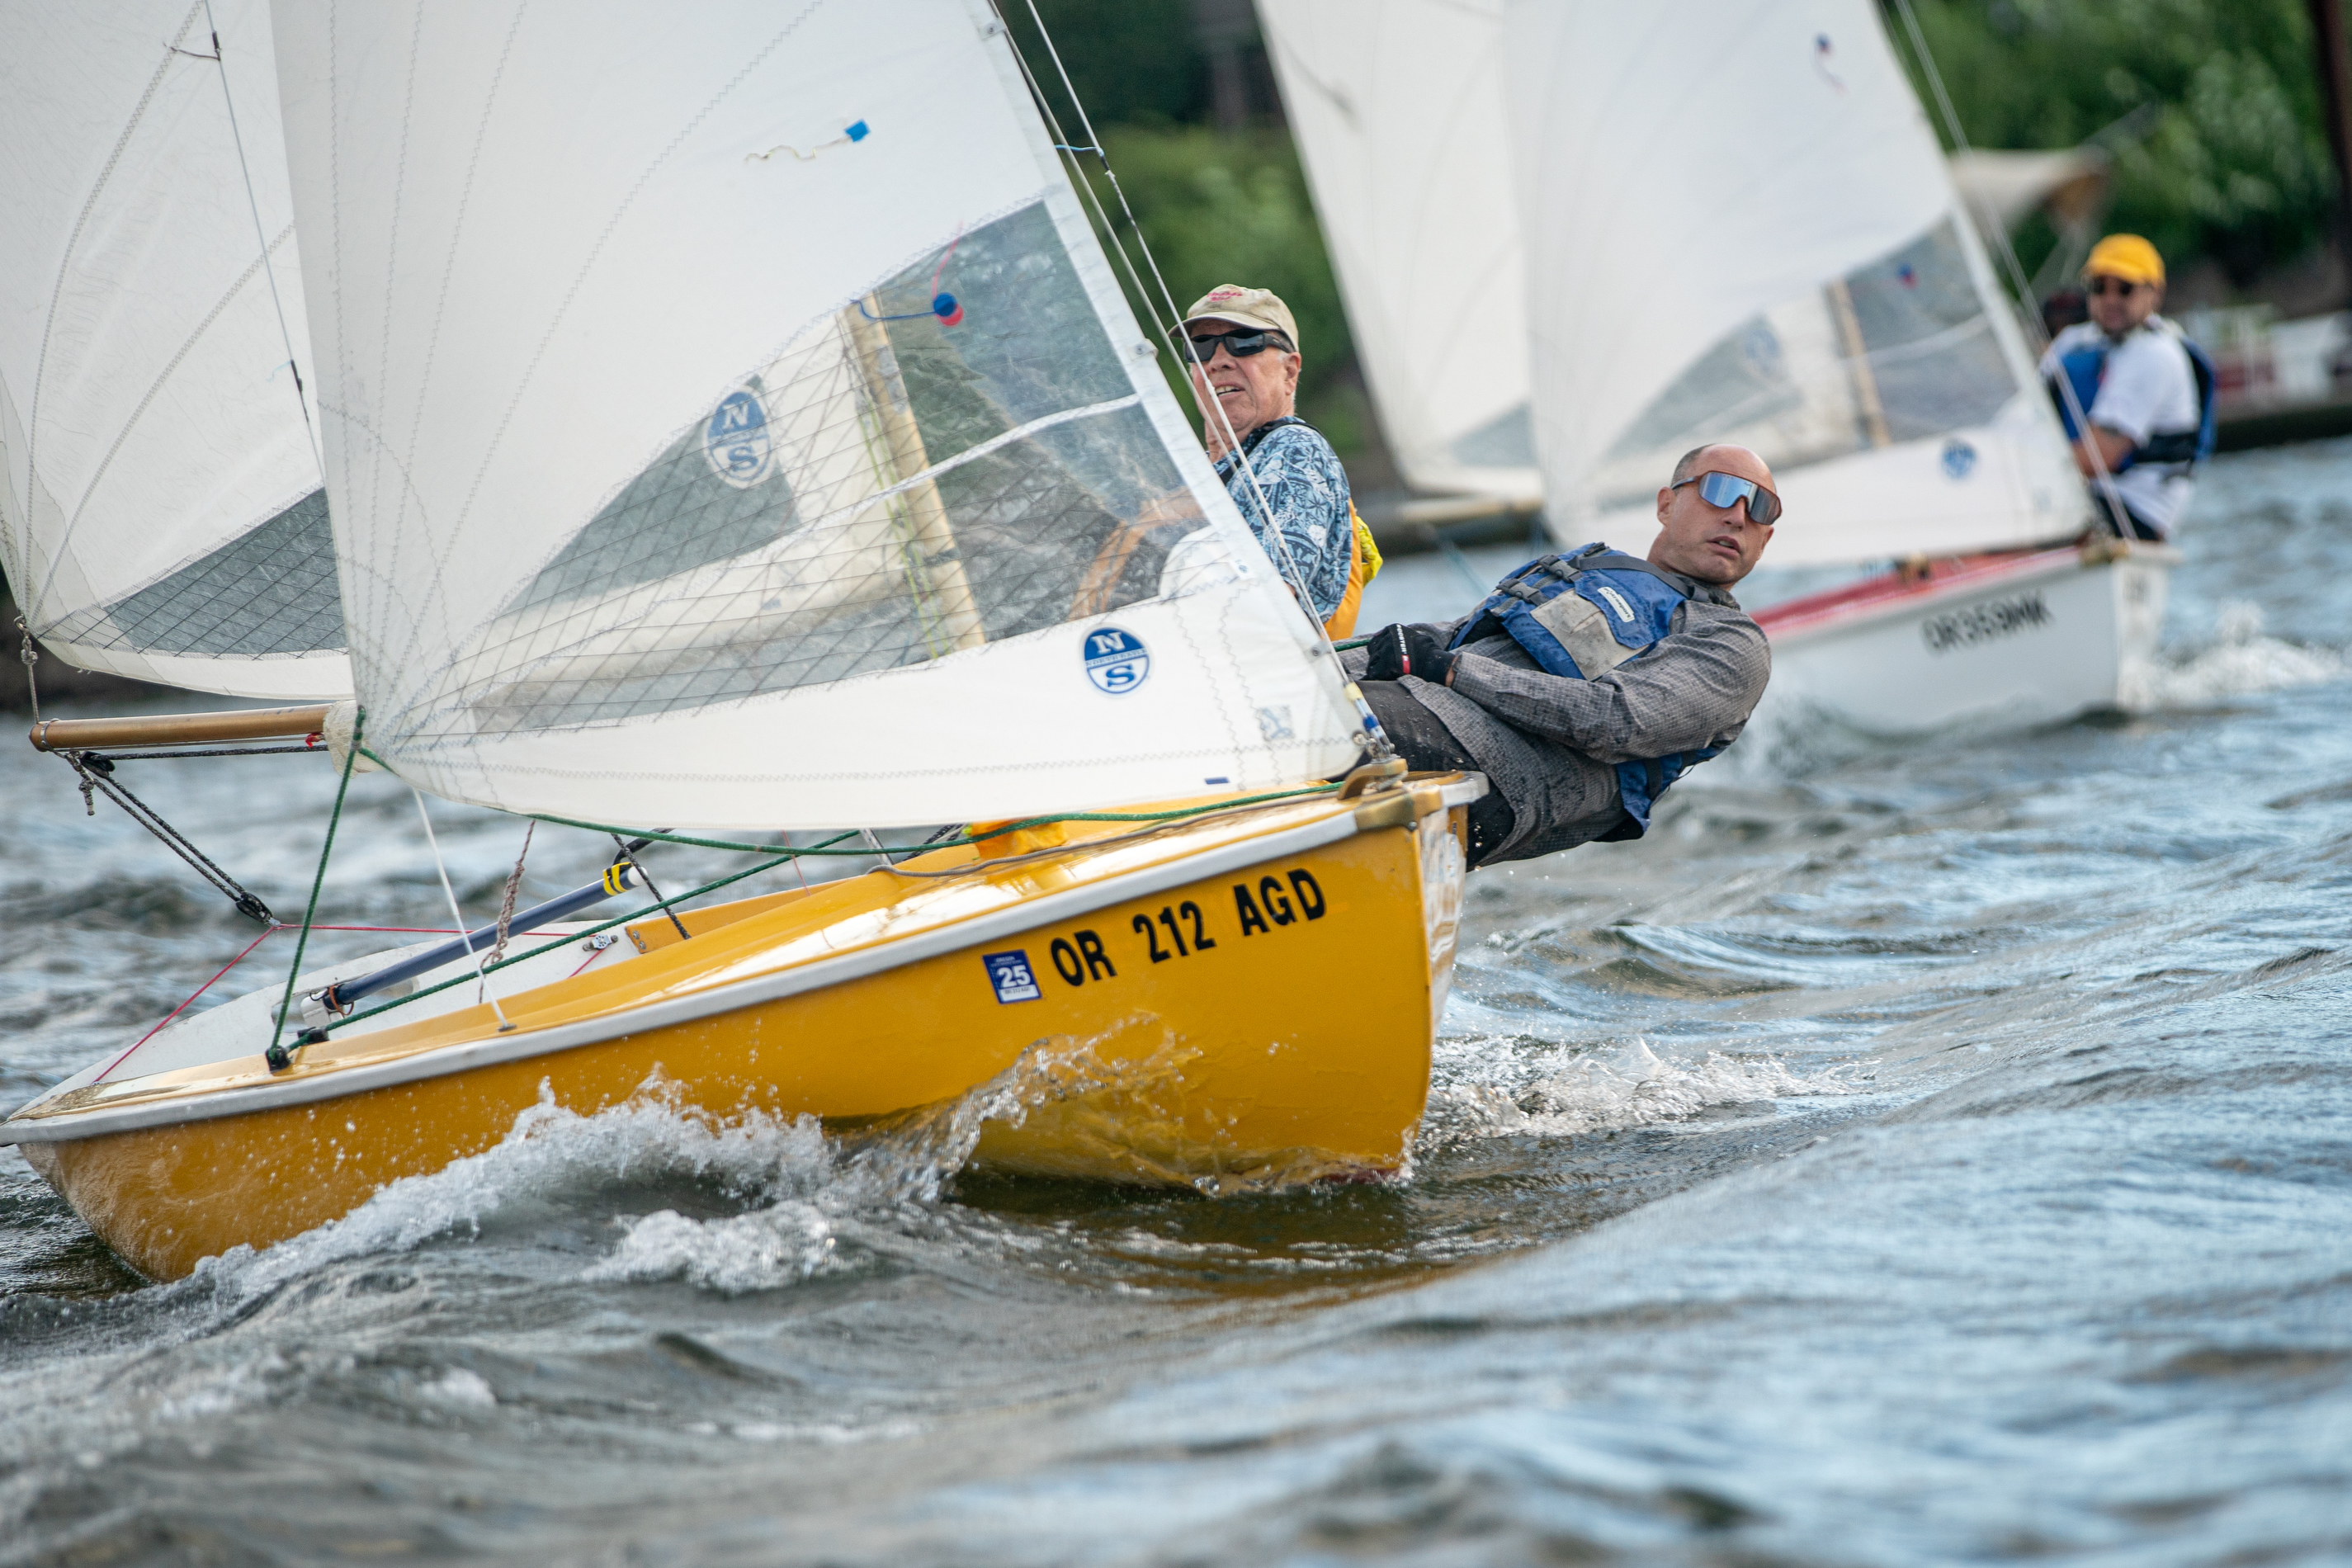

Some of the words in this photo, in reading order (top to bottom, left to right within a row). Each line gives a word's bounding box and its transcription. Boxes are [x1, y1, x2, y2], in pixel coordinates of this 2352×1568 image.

[722, 401, 749, 429] N
[727, 446, 758, 472] S
[1089, 631, 1126, 655] N
[1106, 663, 1136, 687] S
[1050, 928, 1118, 987] OR
[1131, 900, 1218, 965] 212
[1232, 867, 1327, 937] AGD
[996, 964, 1031, 988] 25
